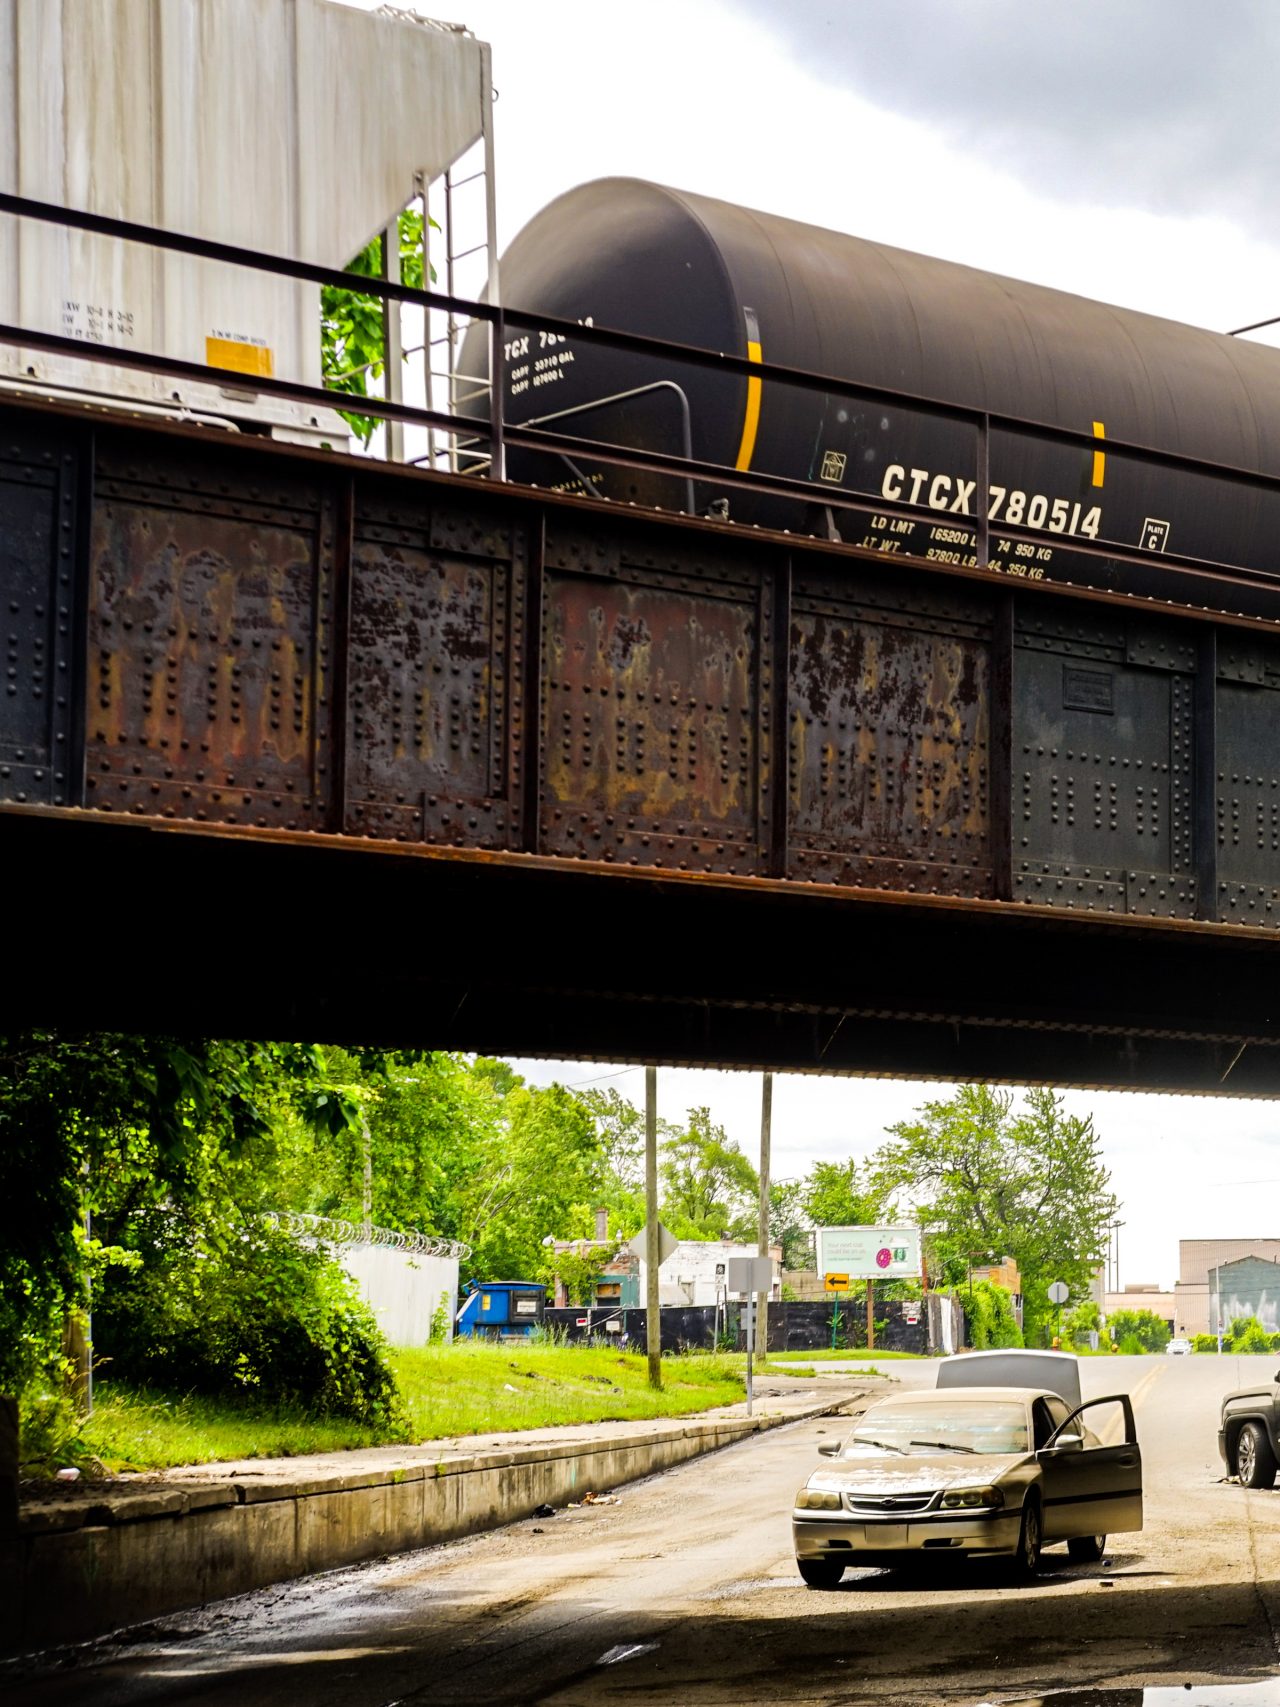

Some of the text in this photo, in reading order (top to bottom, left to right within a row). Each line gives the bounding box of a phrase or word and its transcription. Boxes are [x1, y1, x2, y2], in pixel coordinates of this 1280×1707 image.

[504, 336, 530, 361] TCX
[558, 350, 575, 364] GAL
[881, 464, 1102, 539] CTCX 780514
[870, 515, 887, 529] LD
[889, 519, 915, 535] LMT
[929, 527, 969, 545] 165200
[997, 540, 1011, 553] 74
[1015, 543, 1035, 557] 950
[1036, 547, 1052, 561] KG
[1147, 524, 1164, 535] PLATE
[1148, 535, 1158, 549] C
[862, 536, 877, 549] LT
[881, 539, 900, 553] WT
[1006, 563, 1027, 576] 350
[1028, 567, 1044, 580] KG
